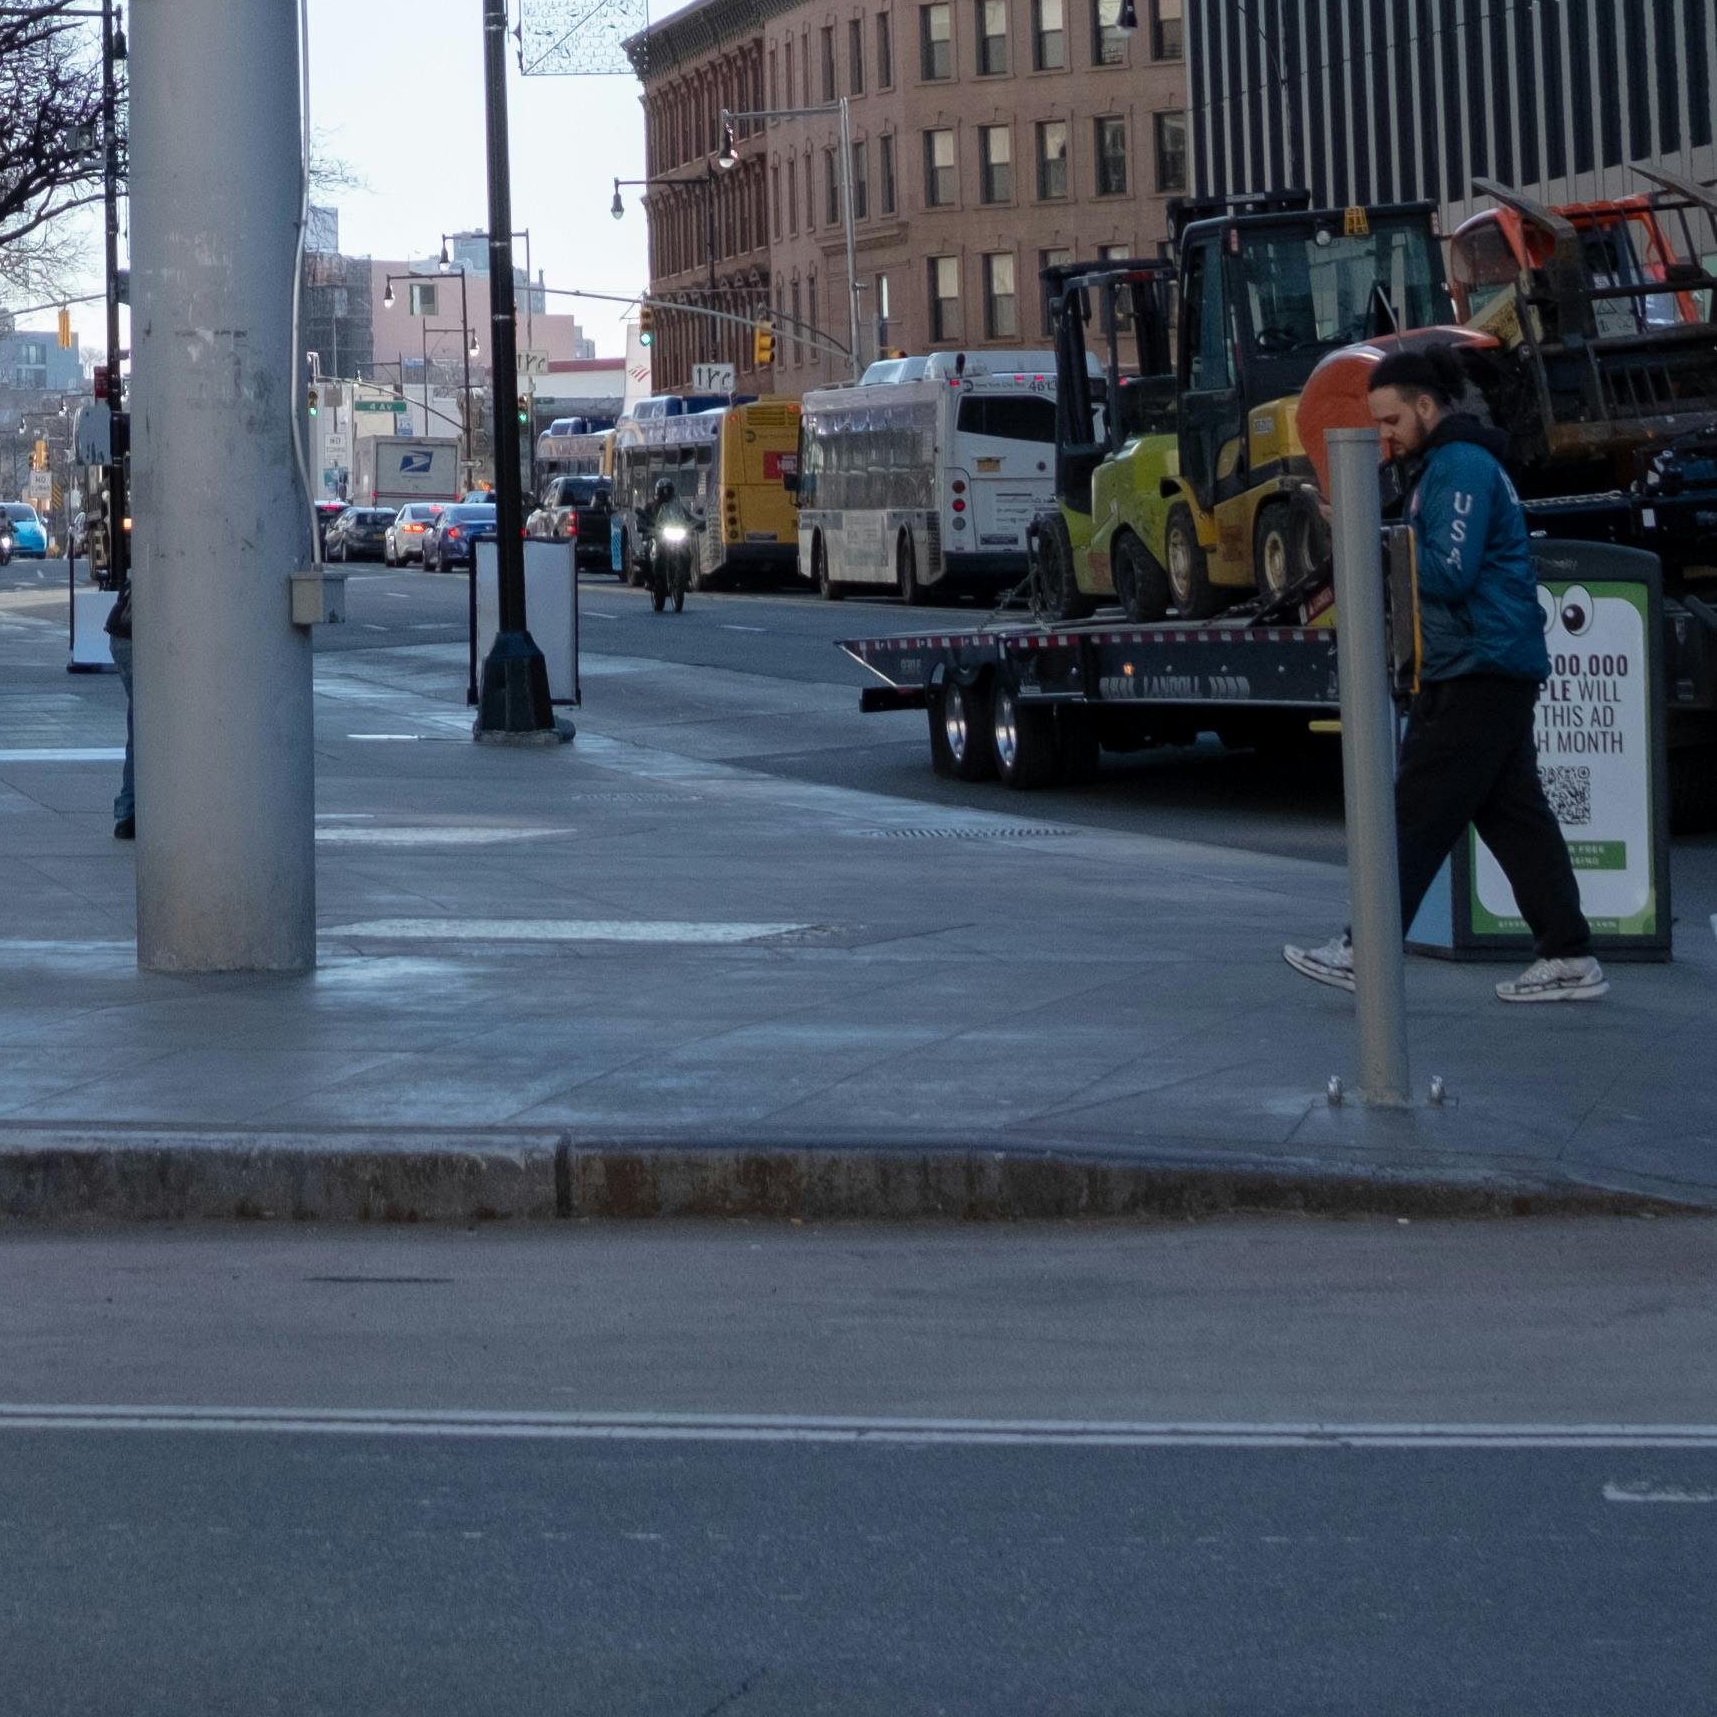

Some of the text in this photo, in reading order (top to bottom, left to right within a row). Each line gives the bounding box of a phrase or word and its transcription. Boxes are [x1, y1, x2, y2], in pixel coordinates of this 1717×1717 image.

[1577, 679, 1623, 703] WILL
[1541, 705, 1615, 728] THIS AD
[1557, 730, 1624, 754] MONTH
